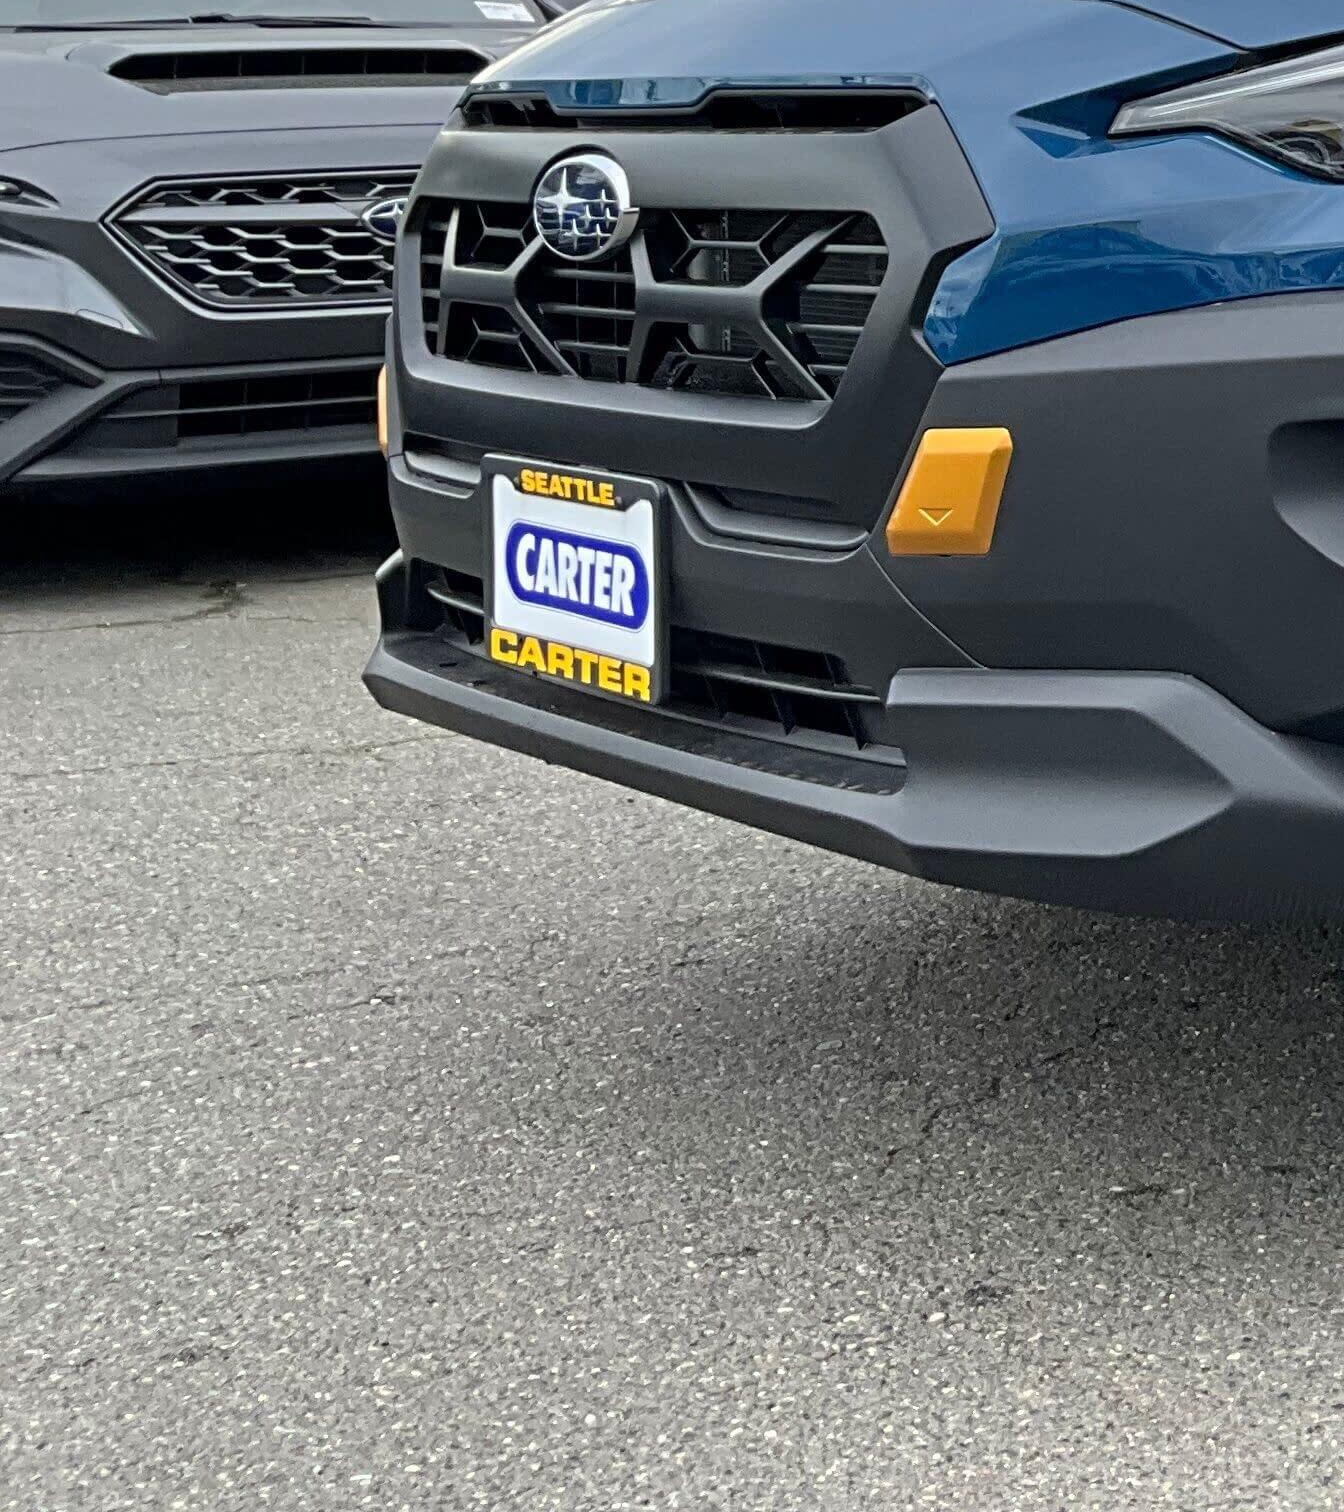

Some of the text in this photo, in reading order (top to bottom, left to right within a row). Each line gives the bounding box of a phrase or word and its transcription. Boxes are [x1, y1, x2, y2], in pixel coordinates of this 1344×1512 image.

[520, 469, 616, 507] SEATTLE
[516, 532, 636, 617] CARTER
[490, 628, 651, 703] CARTER
